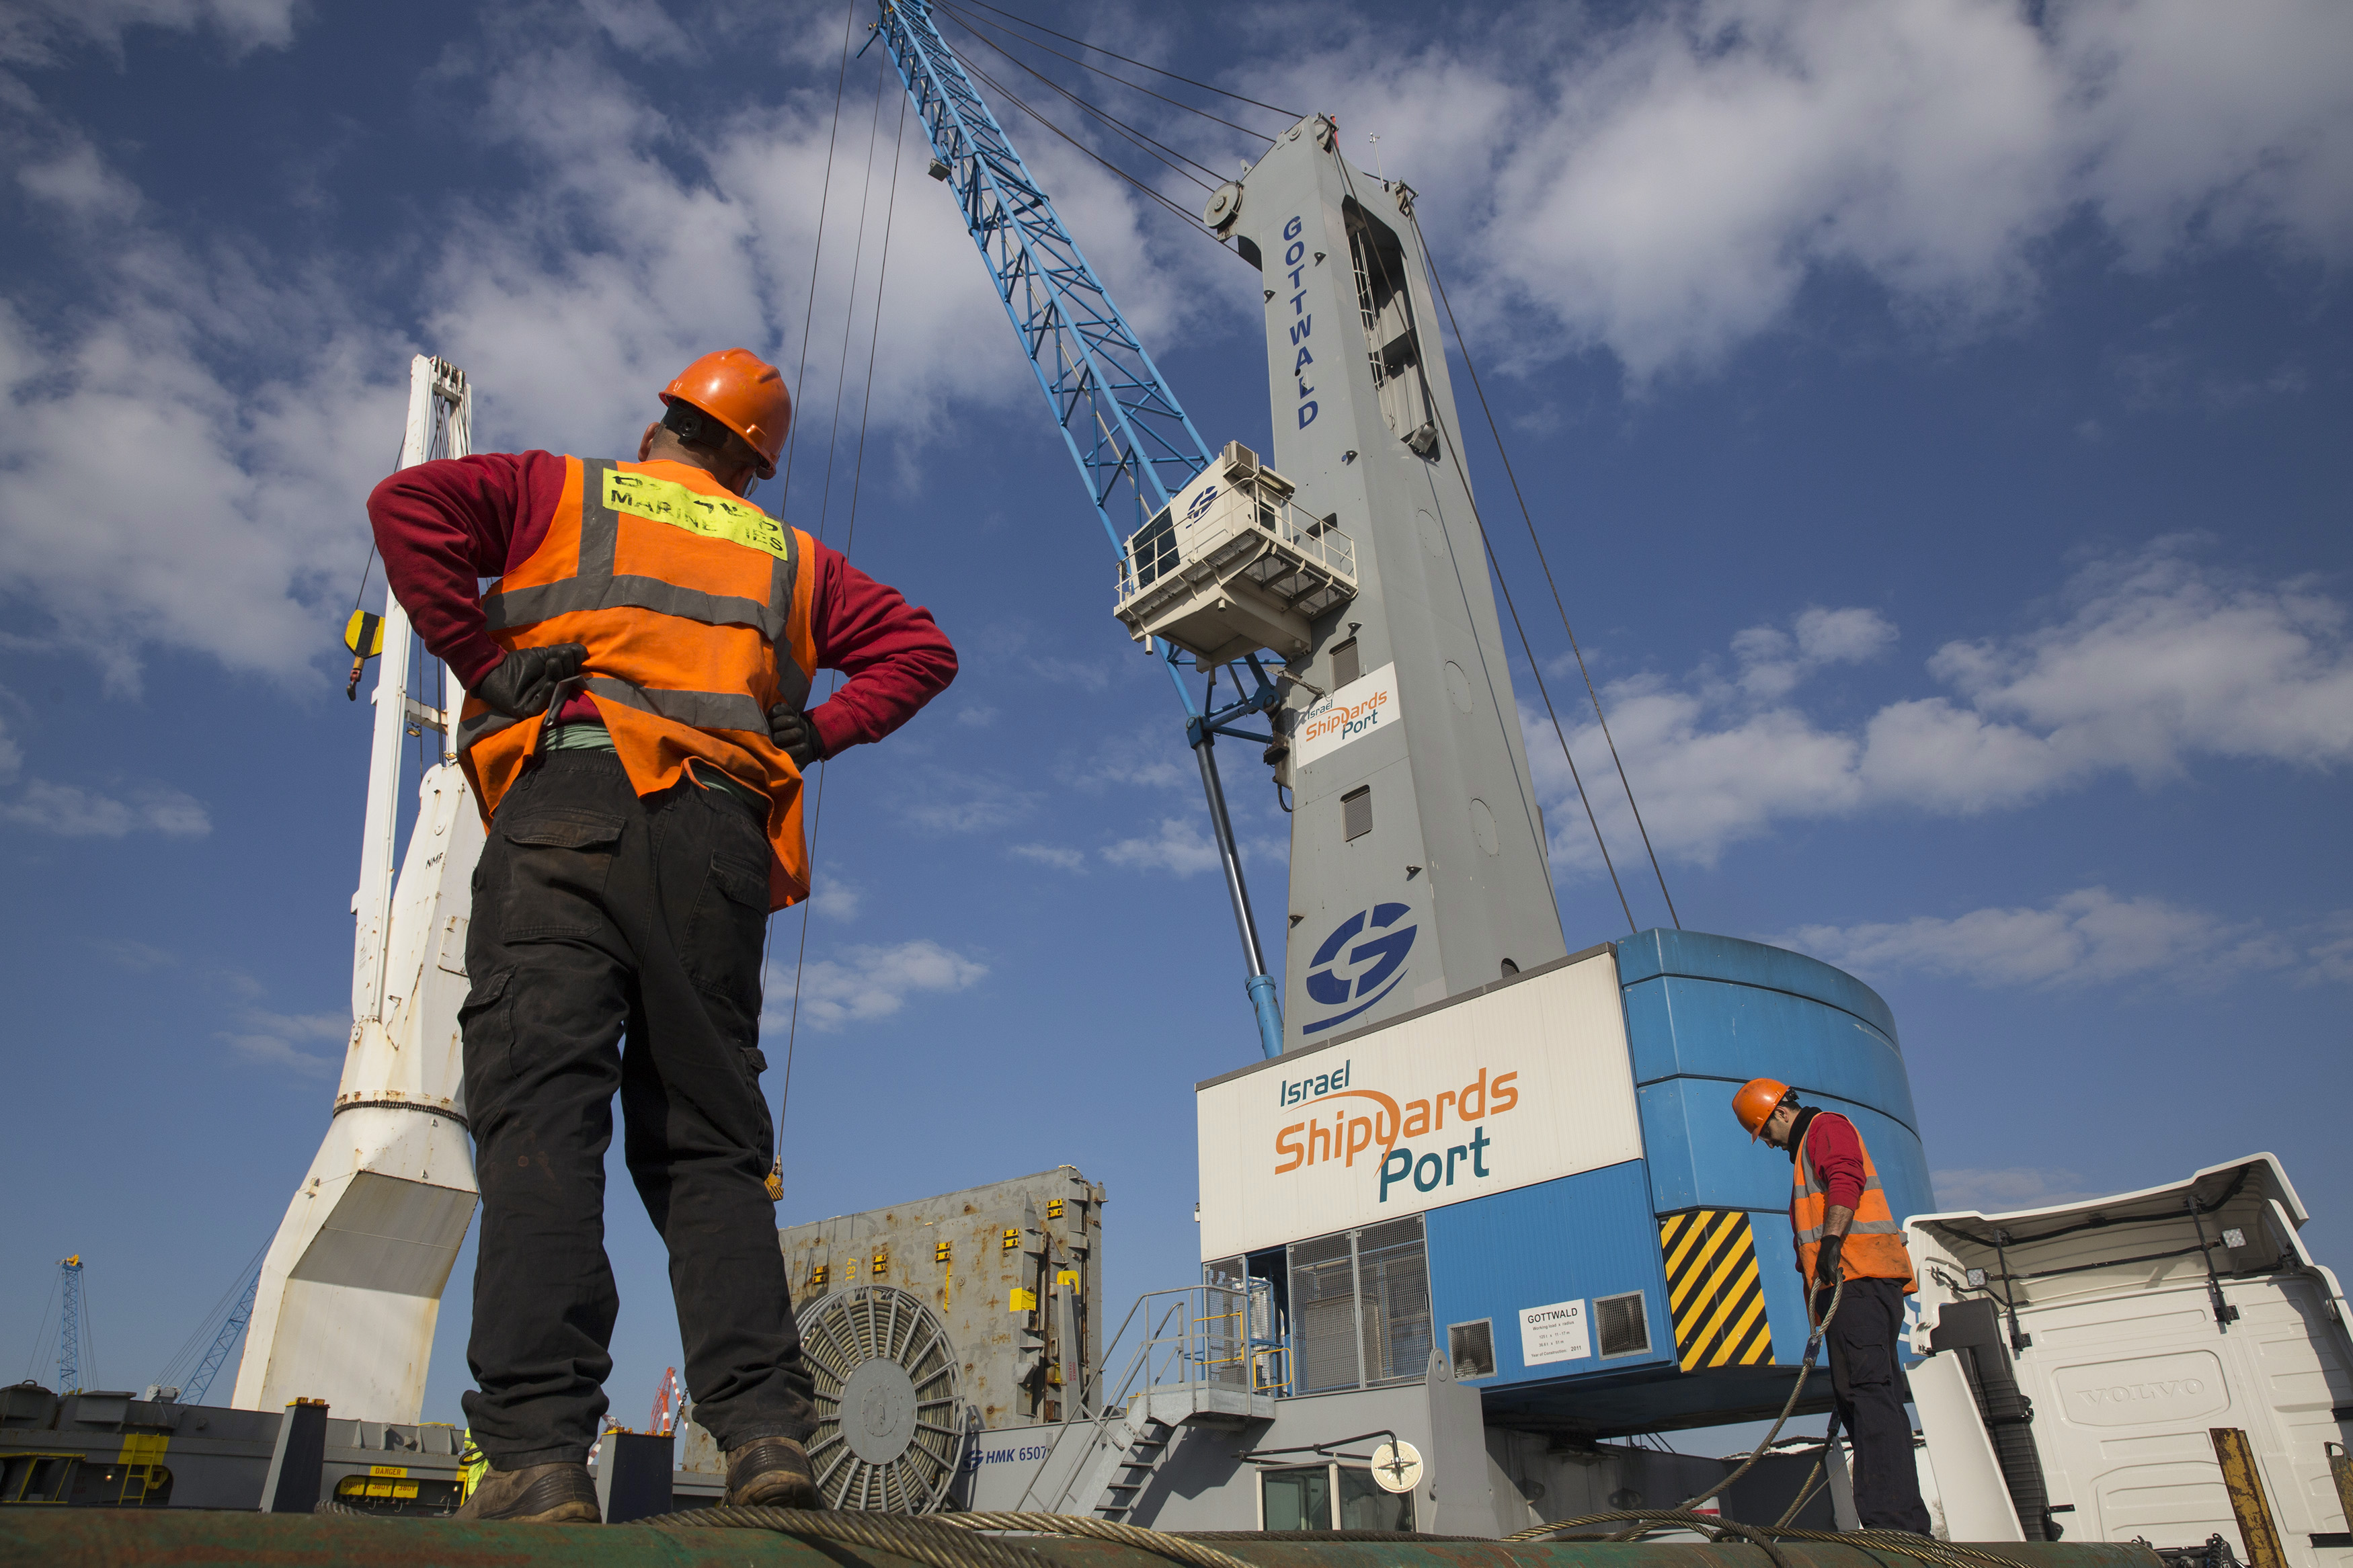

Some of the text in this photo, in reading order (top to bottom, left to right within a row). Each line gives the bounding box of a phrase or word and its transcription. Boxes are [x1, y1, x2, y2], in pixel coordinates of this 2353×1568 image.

[1283, 216, 1318, 430] GOTTWALD
[1306, 691, 1388, 743] Shipyards
[1308, 699, 1332, 720] Israel
[1342, 709, 1378, 740] Port
[1280, 1059, 1351, 1108] Israel
[1275, 1067, 1519, 1179] Shipyards
[1379, 1126, 1490, 1203] Port
[1527, 1307, 1578, 1323] GOTTWALD
[2075, 1378, 2204, 1406] VOLVO
[986, 1448, 1016, 1464] HMK
[1019, 1446, 1047, 1461] 6507
[375, 1467, 401, 1475] DANGER
